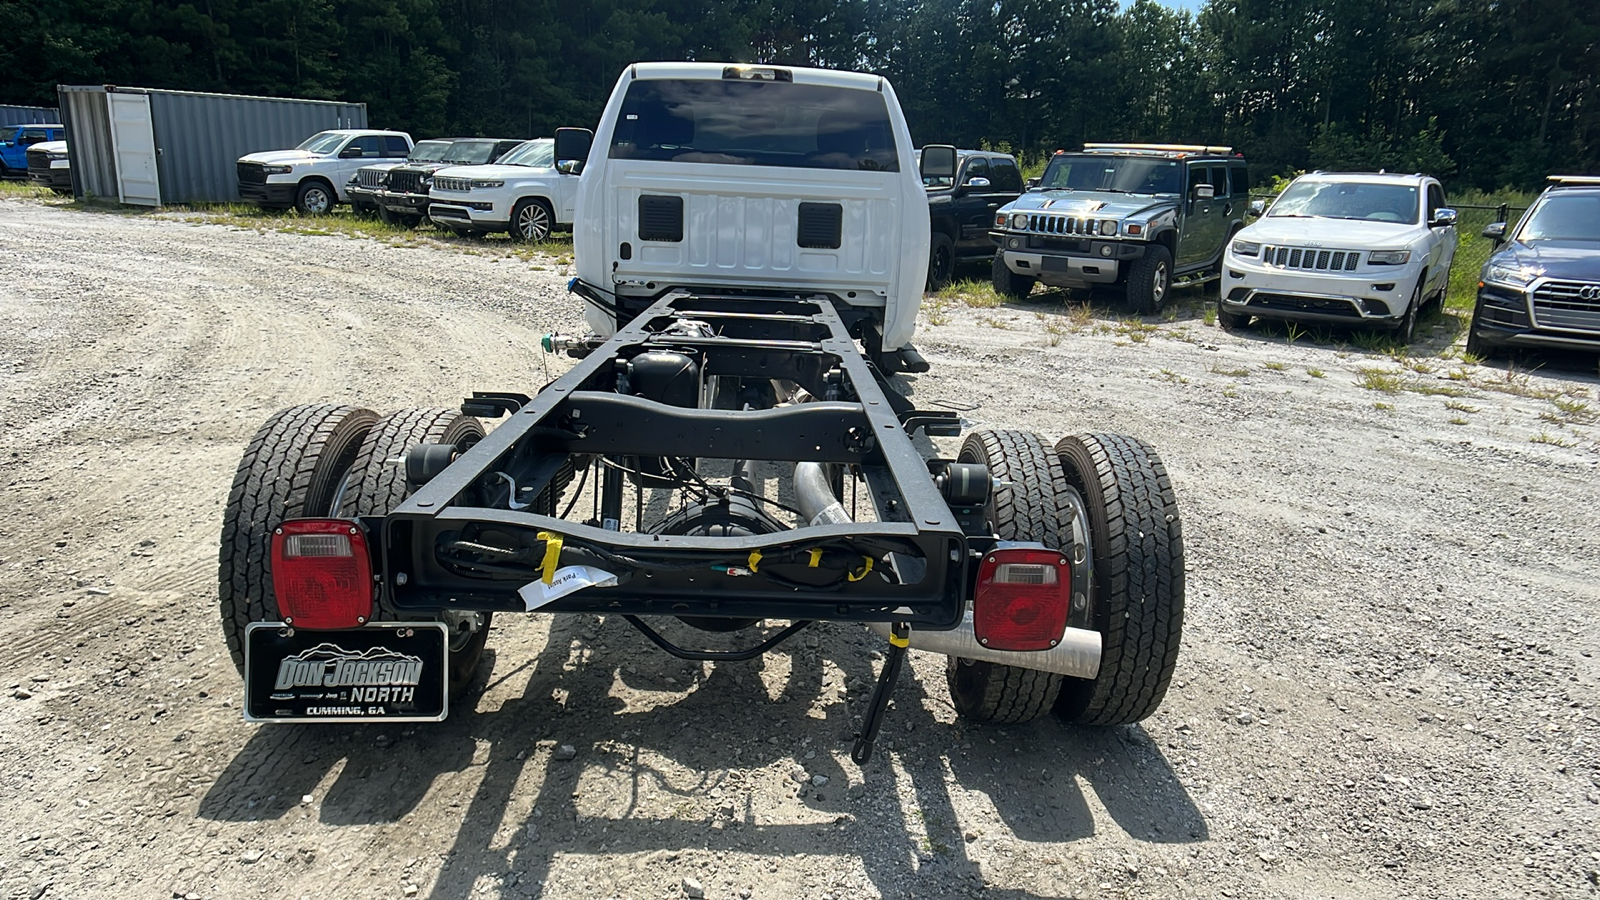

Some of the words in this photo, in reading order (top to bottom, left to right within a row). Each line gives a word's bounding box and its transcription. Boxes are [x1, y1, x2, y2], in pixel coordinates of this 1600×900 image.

[562, 572, 577, 582] Park
[547, 578, 562, 590] Assist
[274, 659, 326, 690] DON
[323, 659, 424, 687] JACKSON
[350, 686, 415, 702] NORTH
[306, 706, 365, 716] CUMMING,
[368, 706, 386, 715] GA
